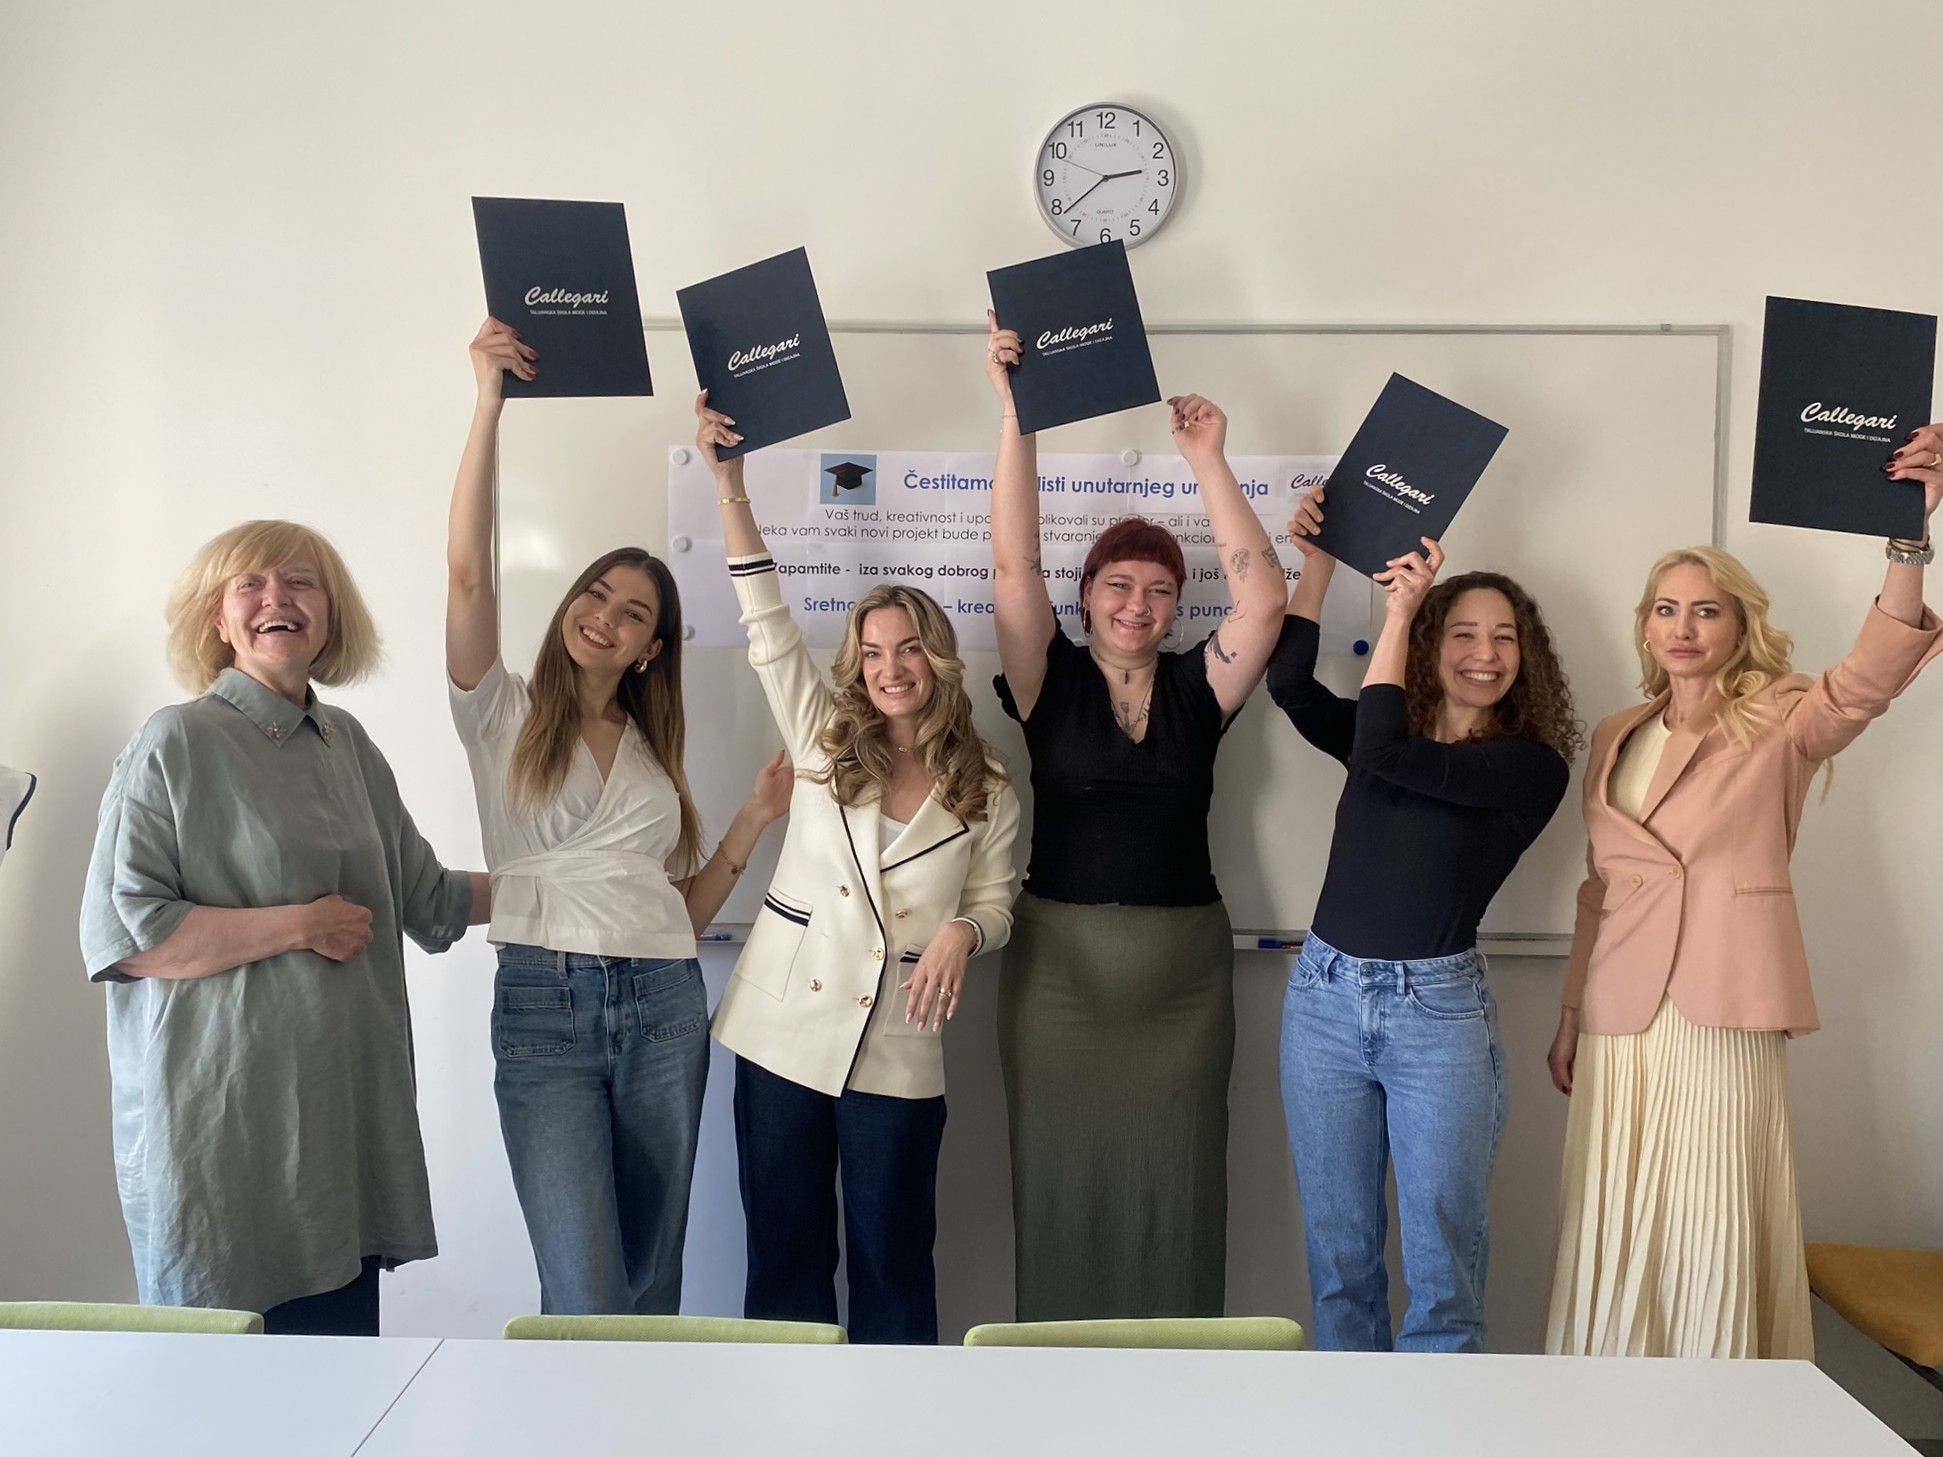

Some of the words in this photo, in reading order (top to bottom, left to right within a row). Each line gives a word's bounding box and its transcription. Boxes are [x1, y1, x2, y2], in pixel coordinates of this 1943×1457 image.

[1067, 120, 1083, 138] 11
[1096, 112, 1116, 129] 12
[1133, 120, 1140, 137] 1
[1047, 142, 1067, 159] 10
[1152, 142, 1164, 159] 2
[1043, 169, 1055, 186] 9
[1157, 169, 1169, 186] 3
[1051, 199, 1063, 215] 8
[1148, 198, 1160, 215] 4
[1070, 219, 1082, 236] 7
[1100, 228, 1112, 243] 6
[1129, 219, 1141, 236] 5
[524, 286, 609, 309] Callegari
[1036, 318, 1113, 349] Callegari
[727, 333, 801, 371] Callegari
[1800, 402, 1898, 431] Callegari
[1071, 478, 1175, 498] unutarnjeg
[1366, 464, 1436, 505] Callegari
[825, 508, 848, 520] Vaš
[853, 510, 882, 522] trud,
[886, 511, 956, 525] kreativnost
[1091, 517, 1106, 526] su
[1169, 516, 1184, 527] ali
[1193, 517, 1210, 527] va
[791, 527, 821, 537] vam
[824, 525, 858, 537] svaki
[860, 526, 889, 538] novi
[892, 528, 939, 542] projekt
[942, 529, 979, 541] bude
[859, 563, 879, 576] iza
[882, 565, 934, 579] svakog
[937, 565, 989, 580] dobrog
[1055, 567, 1082, 581] stoji
[1198, 568, 1220, 582] još
